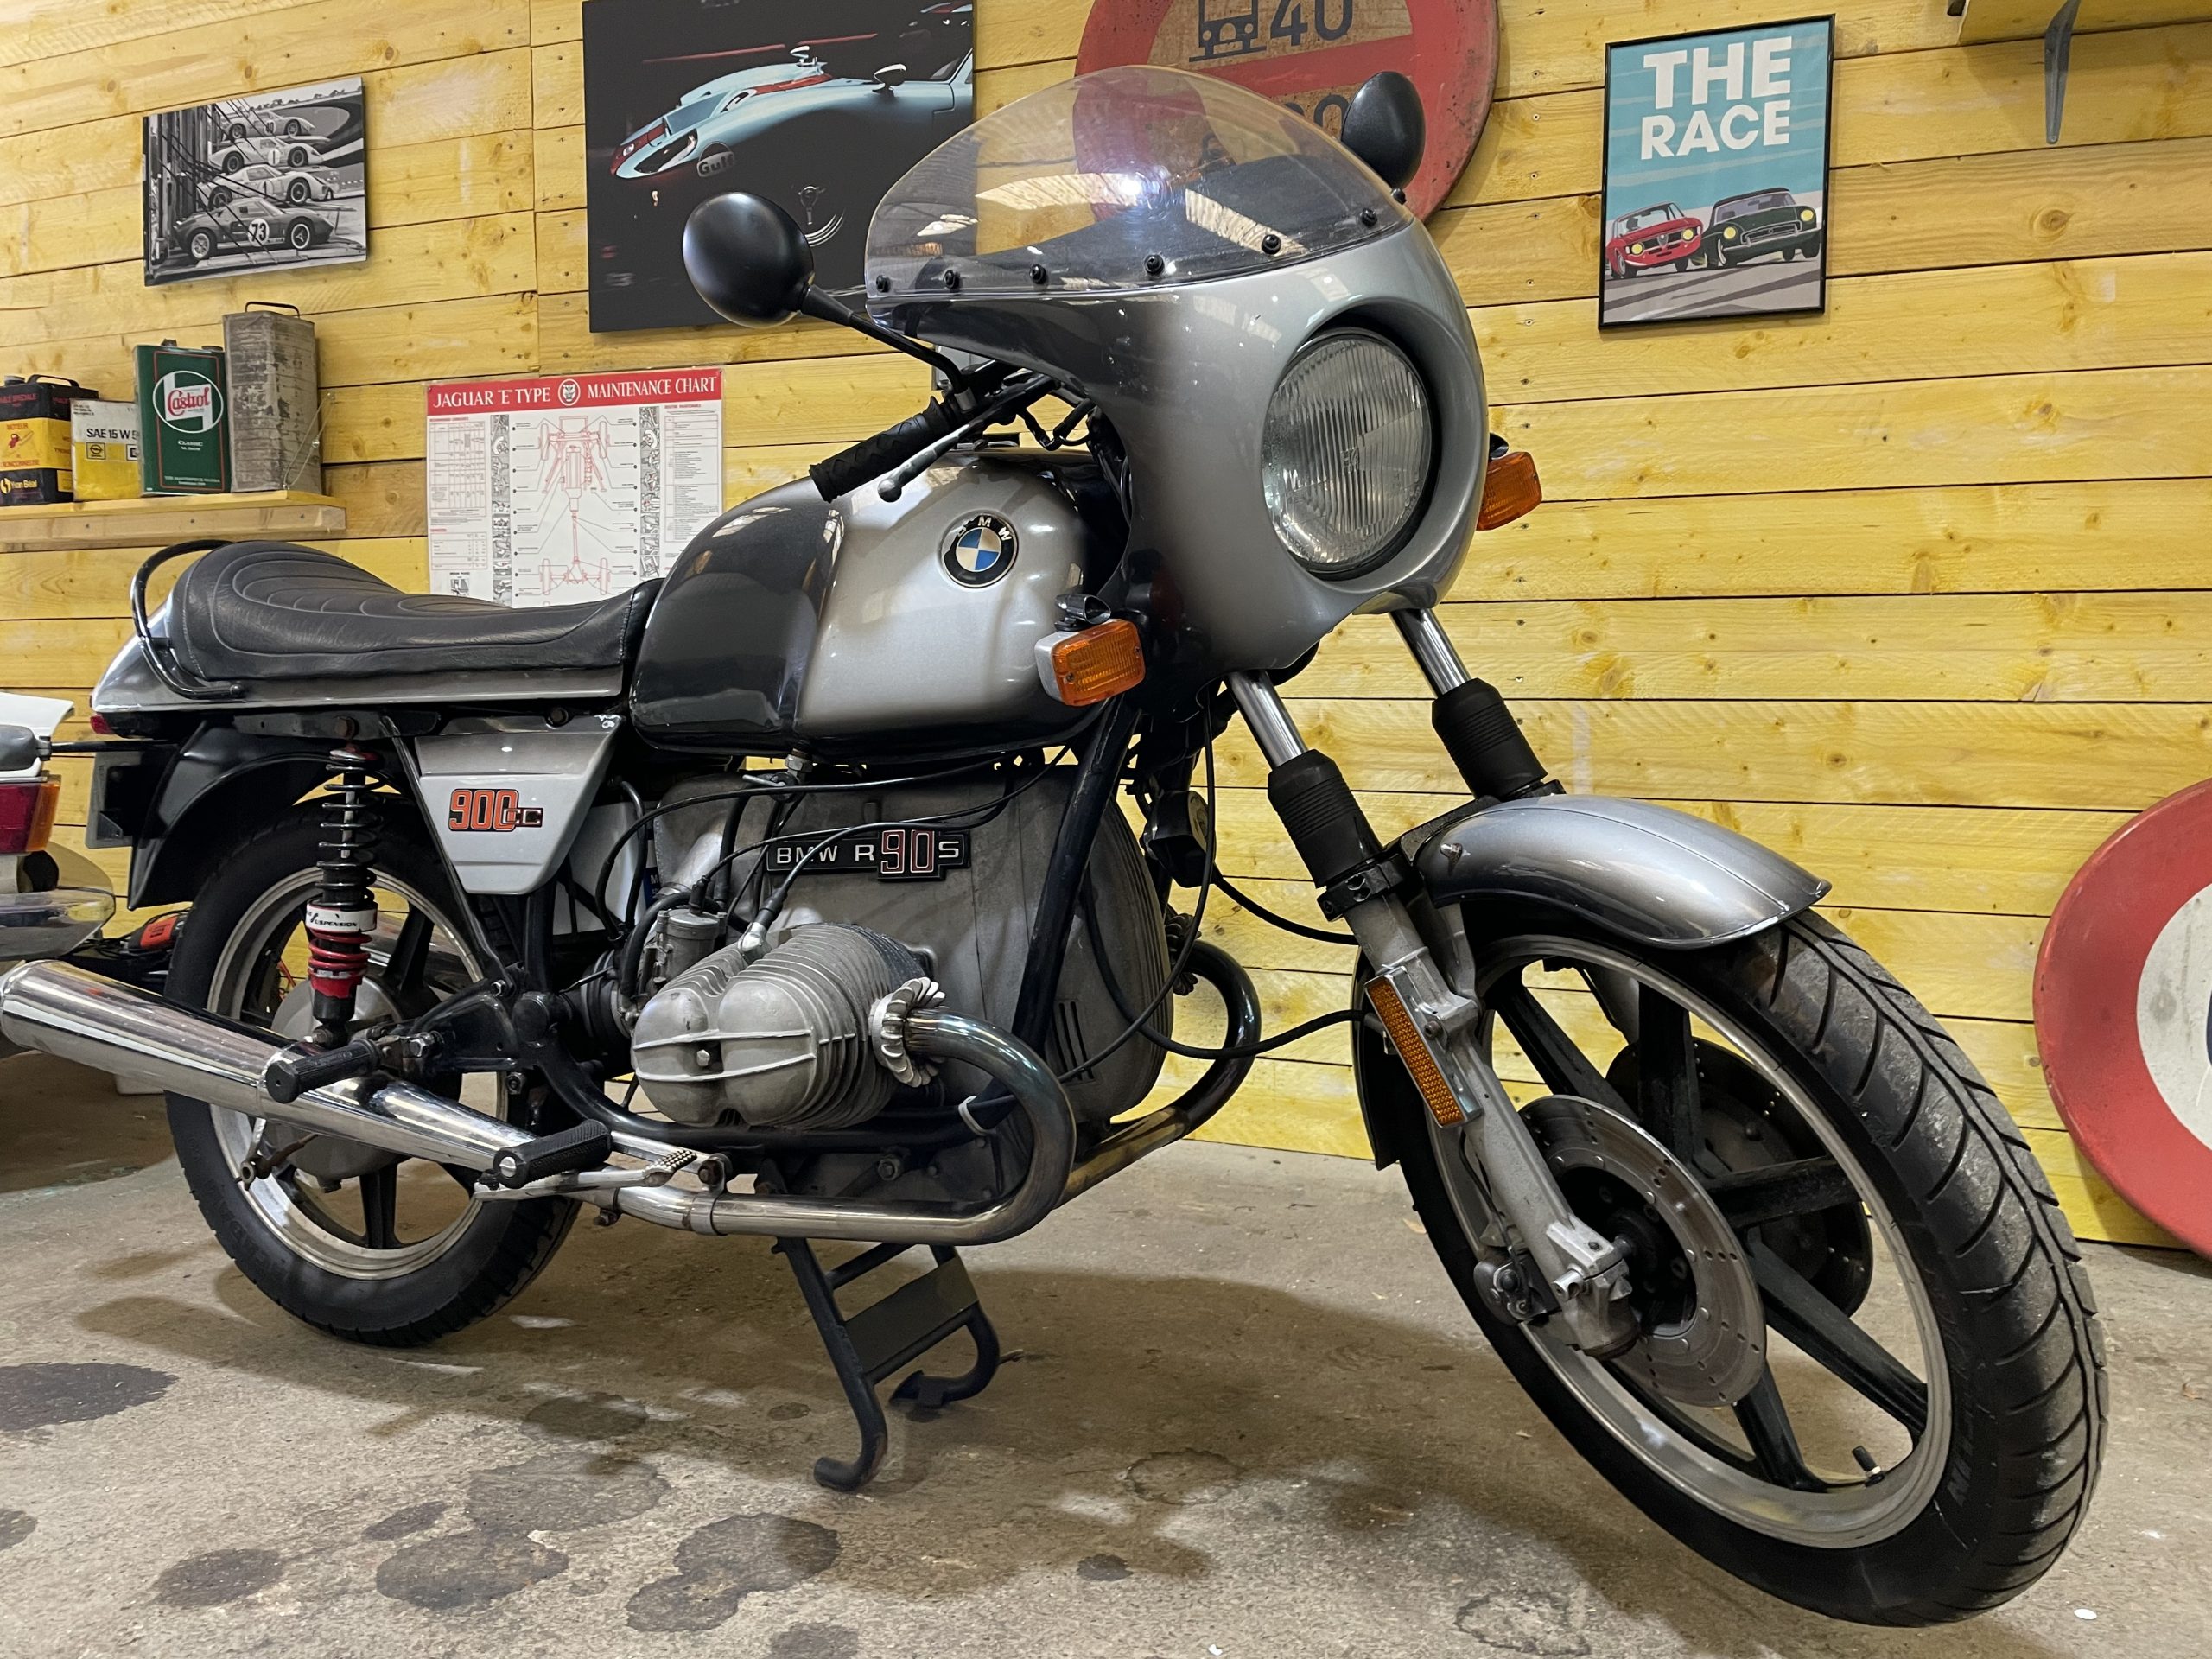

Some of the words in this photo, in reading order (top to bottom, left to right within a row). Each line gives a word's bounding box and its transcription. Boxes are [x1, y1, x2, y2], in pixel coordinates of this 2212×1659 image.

[1270, 0, 1353, 46] 40
[1643, 35, 1793, 110] THE
[1641, 99, 1791, 160] RACE
[698, 154, 733, 174] Gulf
[251, 222, 266, 242] 73
[168, 386, 210, 416] Castrol
[433, 391, 493, 408] JAGUAR
[515, 387, 550, 403] TYPE
[588, 379, 671, 398] MAINTENANCE
[675, 377, 717, 393] CHART
[86, 428, 107, 439] SAE
[108, 429, 118, 439] 15
[119, 430, 130, 440] W
[777, 844, 838, 865] BMW
